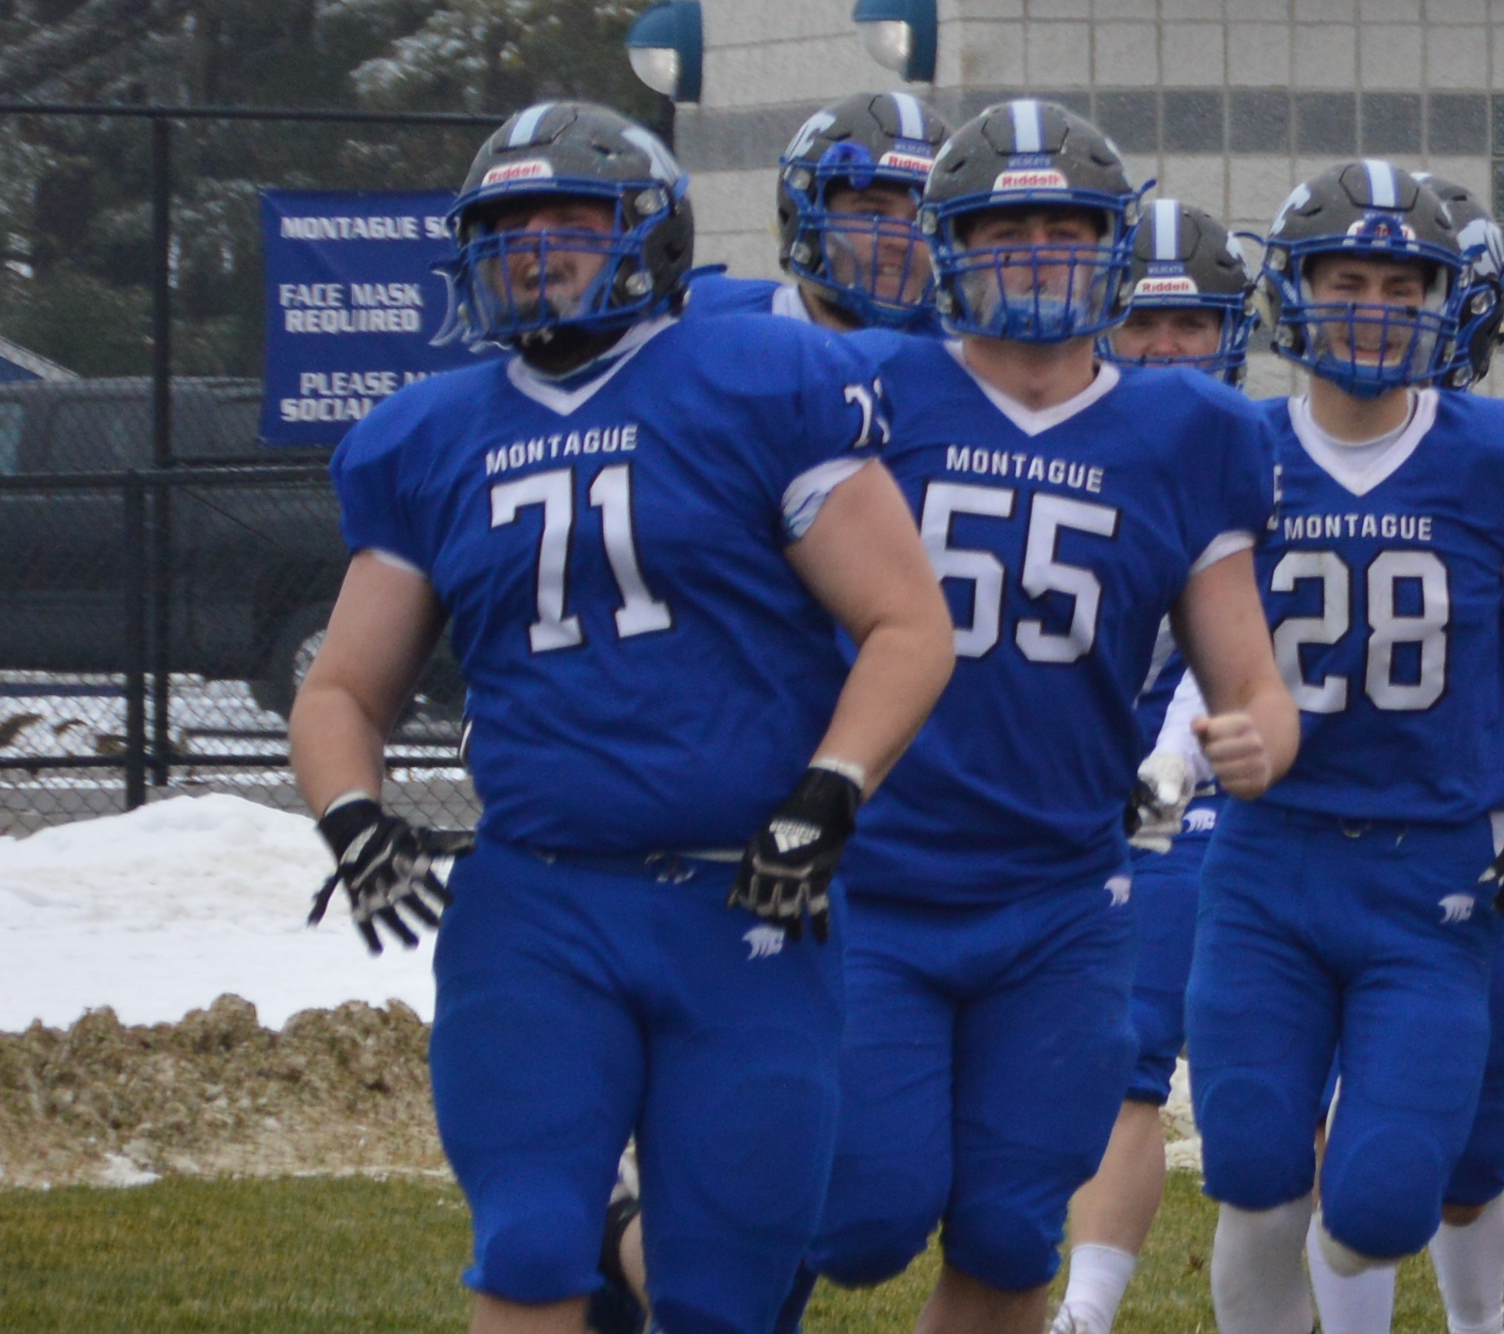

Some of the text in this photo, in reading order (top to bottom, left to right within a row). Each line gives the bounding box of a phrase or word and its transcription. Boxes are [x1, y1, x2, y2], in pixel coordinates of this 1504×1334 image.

[280, 216, 421, 240] MONTAGUE
[279, 283, 424, 308] FACE MASK
[285, 309, 422, 335] REQUIRED
[300, 372, 398, 396] PLEASE
[486, 425, 638, 475] MONTAGUE
[946, 445, 1104, 494] MONTAGUE
[1284, 514, 1432, 541] MONTAGUE
[490, 463, 673, 654] 71
[920, 481, 1118, 664] 55
[1270, 551, 1450, 714] 28
